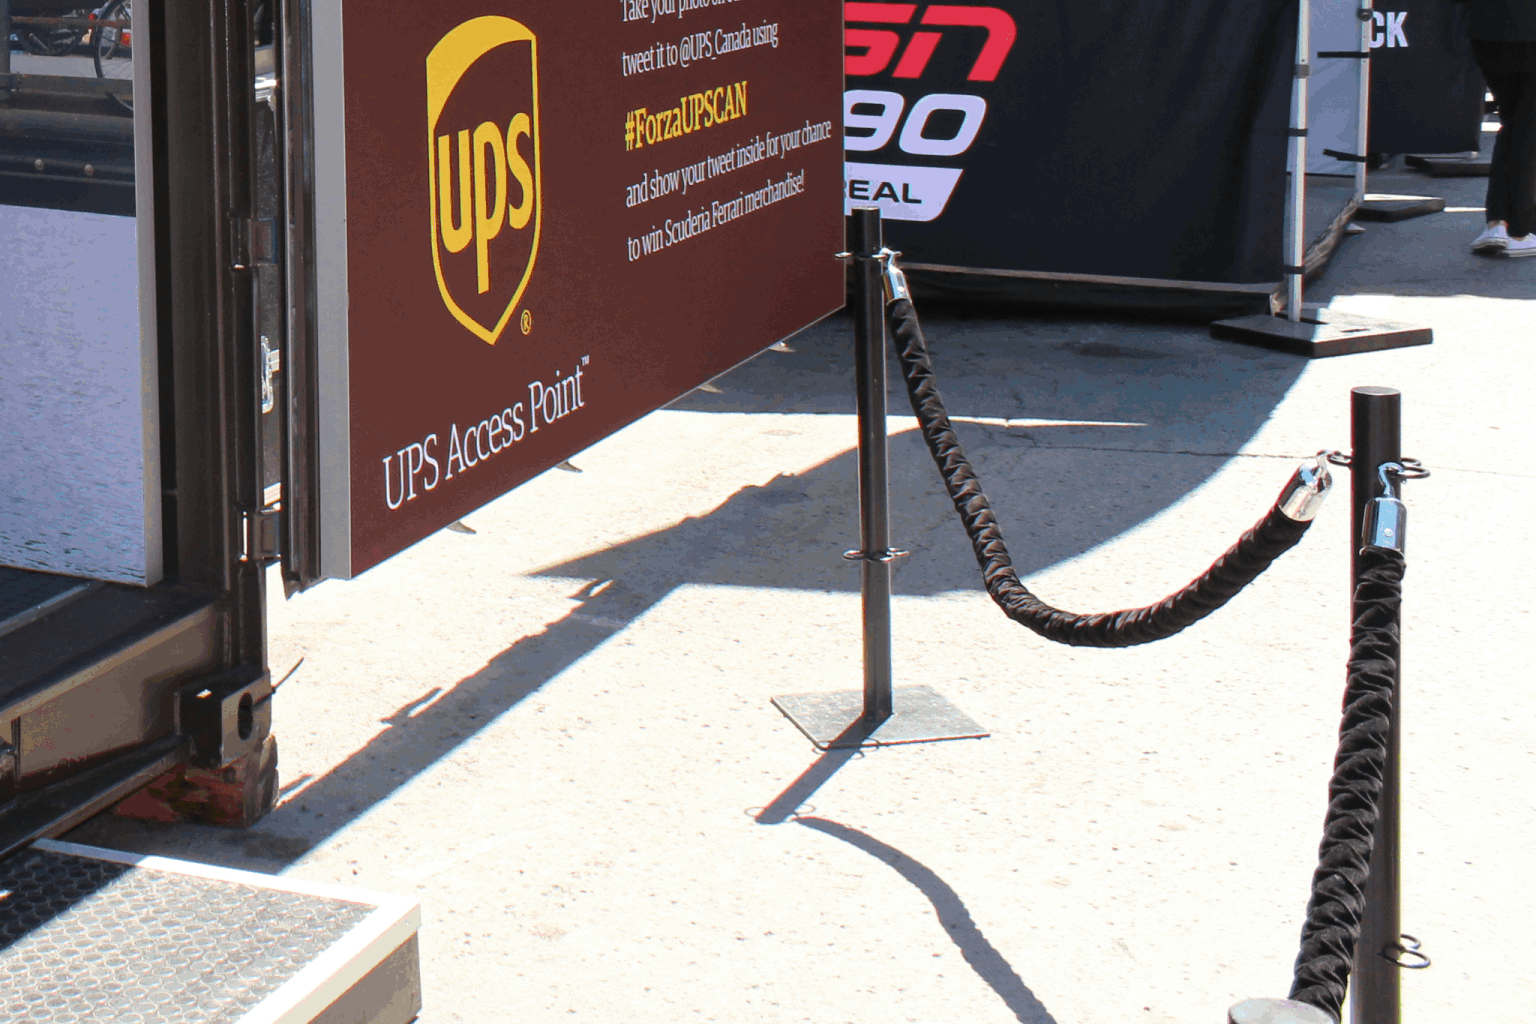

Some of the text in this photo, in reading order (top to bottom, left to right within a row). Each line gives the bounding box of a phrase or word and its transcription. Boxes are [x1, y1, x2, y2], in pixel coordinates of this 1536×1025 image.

[622, 19, 779, 77] tweet it to @UPS_Canada using
[625, 81, 749, 152] #ForzaUPSCAN
[437, 112, 534, 295] ups
[625, 119, 832, 208] and show your tweet inside for your chance
[627, 168, 805, 262] to win Scuderia Ferrari merchandise!
[382, 433, 439, 511] UPS
[444, 399, 524, 481] Access
